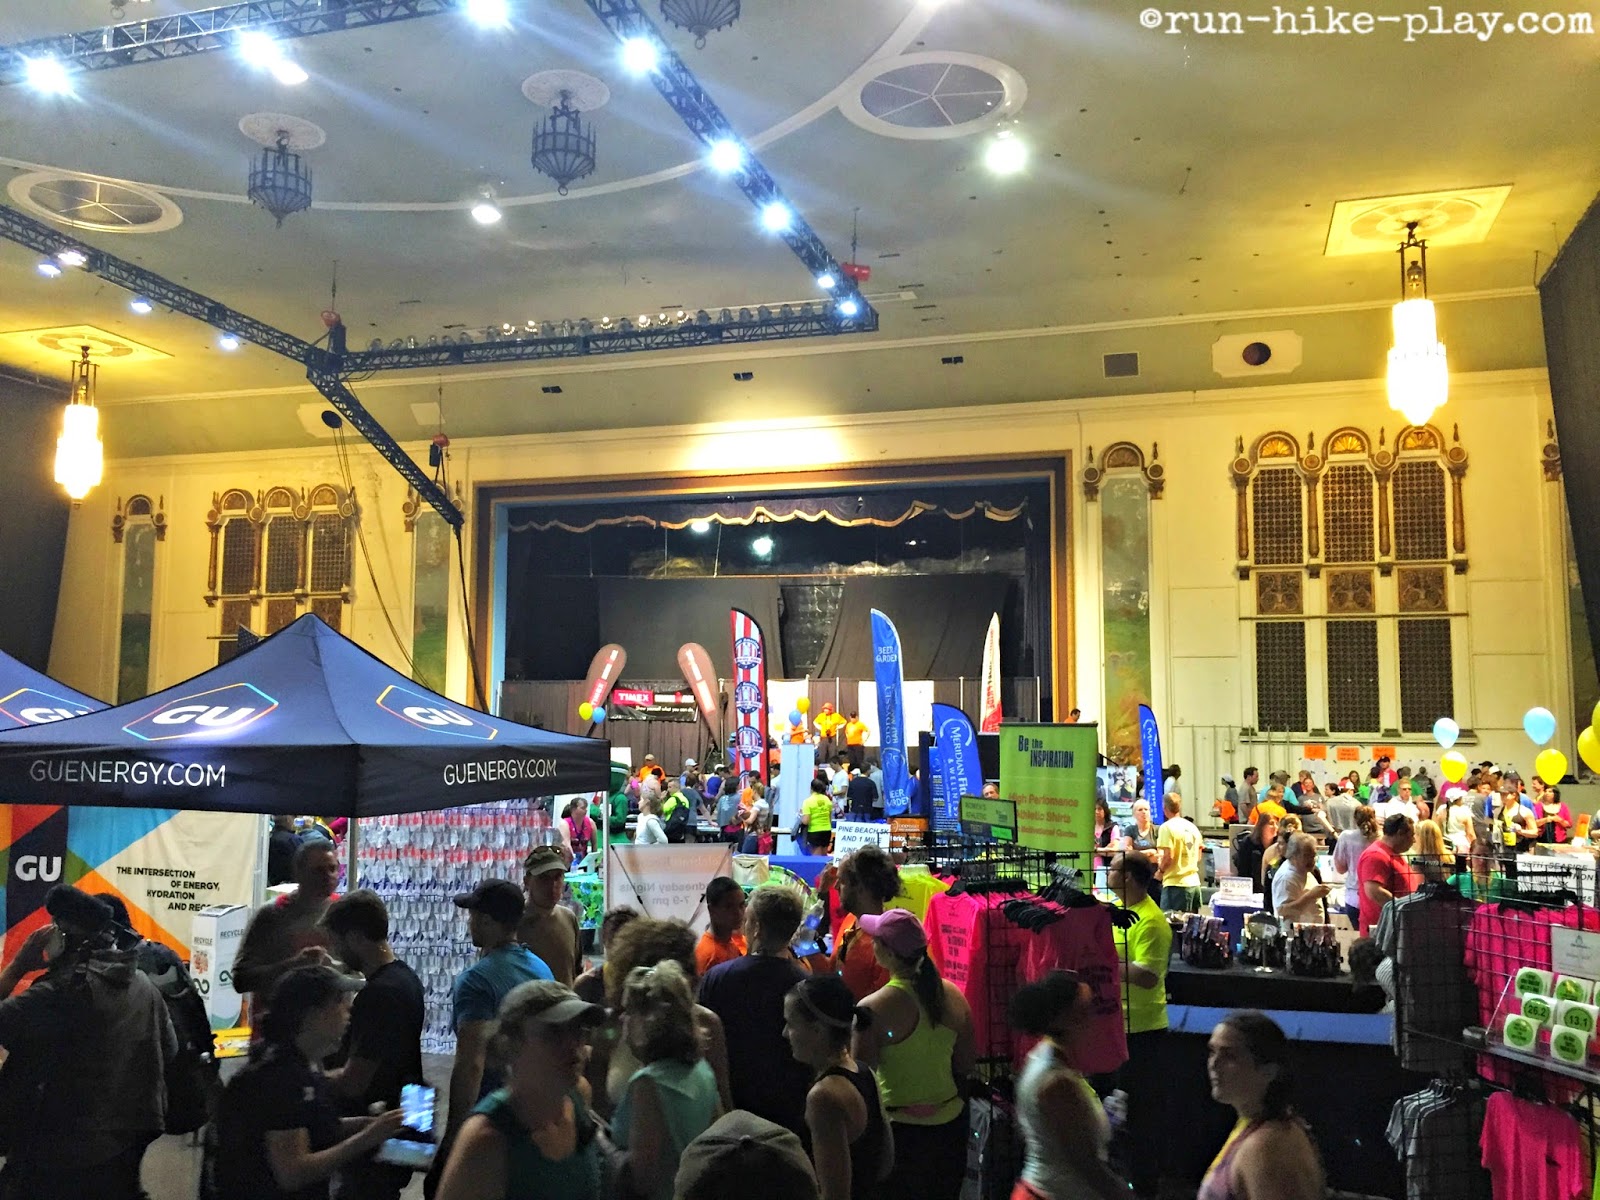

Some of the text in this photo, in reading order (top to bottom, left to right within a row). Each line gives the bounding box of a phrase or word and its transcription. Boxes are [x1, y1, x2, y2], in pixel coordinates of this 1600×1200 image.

[618, 692, 649, 702] TIMEX
[152, 705, 256, 727] GU
[403, 706, 474, 726] GU
[1018, 735, 1043, 752] Be the
[950, 726, 965, 776] MERIDIAN
[1030, 750, 1074, 769] INSPIRATION
[29, 759, 227, 787] GUENERGY.COM
[443, 758, 557, 786] GUENERGY.COM
[837, 825, 854, 833] PINE
[854, 826, 878, 834] BEACH
[864, 836, 882, 844] MILE
[15, 855, 62, 882] GU
[117, 866, 196, 879] THE INTERSECTION
[170, 880, 220, 891] OF ENERGY,
[146, 889, 195, 900] HYDRATION
[168, 902, 187, 911] AND
[220, 928, 244, 938] RECYCLE
[193, 937, 213, 945] RECYCLE
[1528, 1005, 1546, 1017] 26.2
[1569, 1015, 1588, 1027] 13.1
